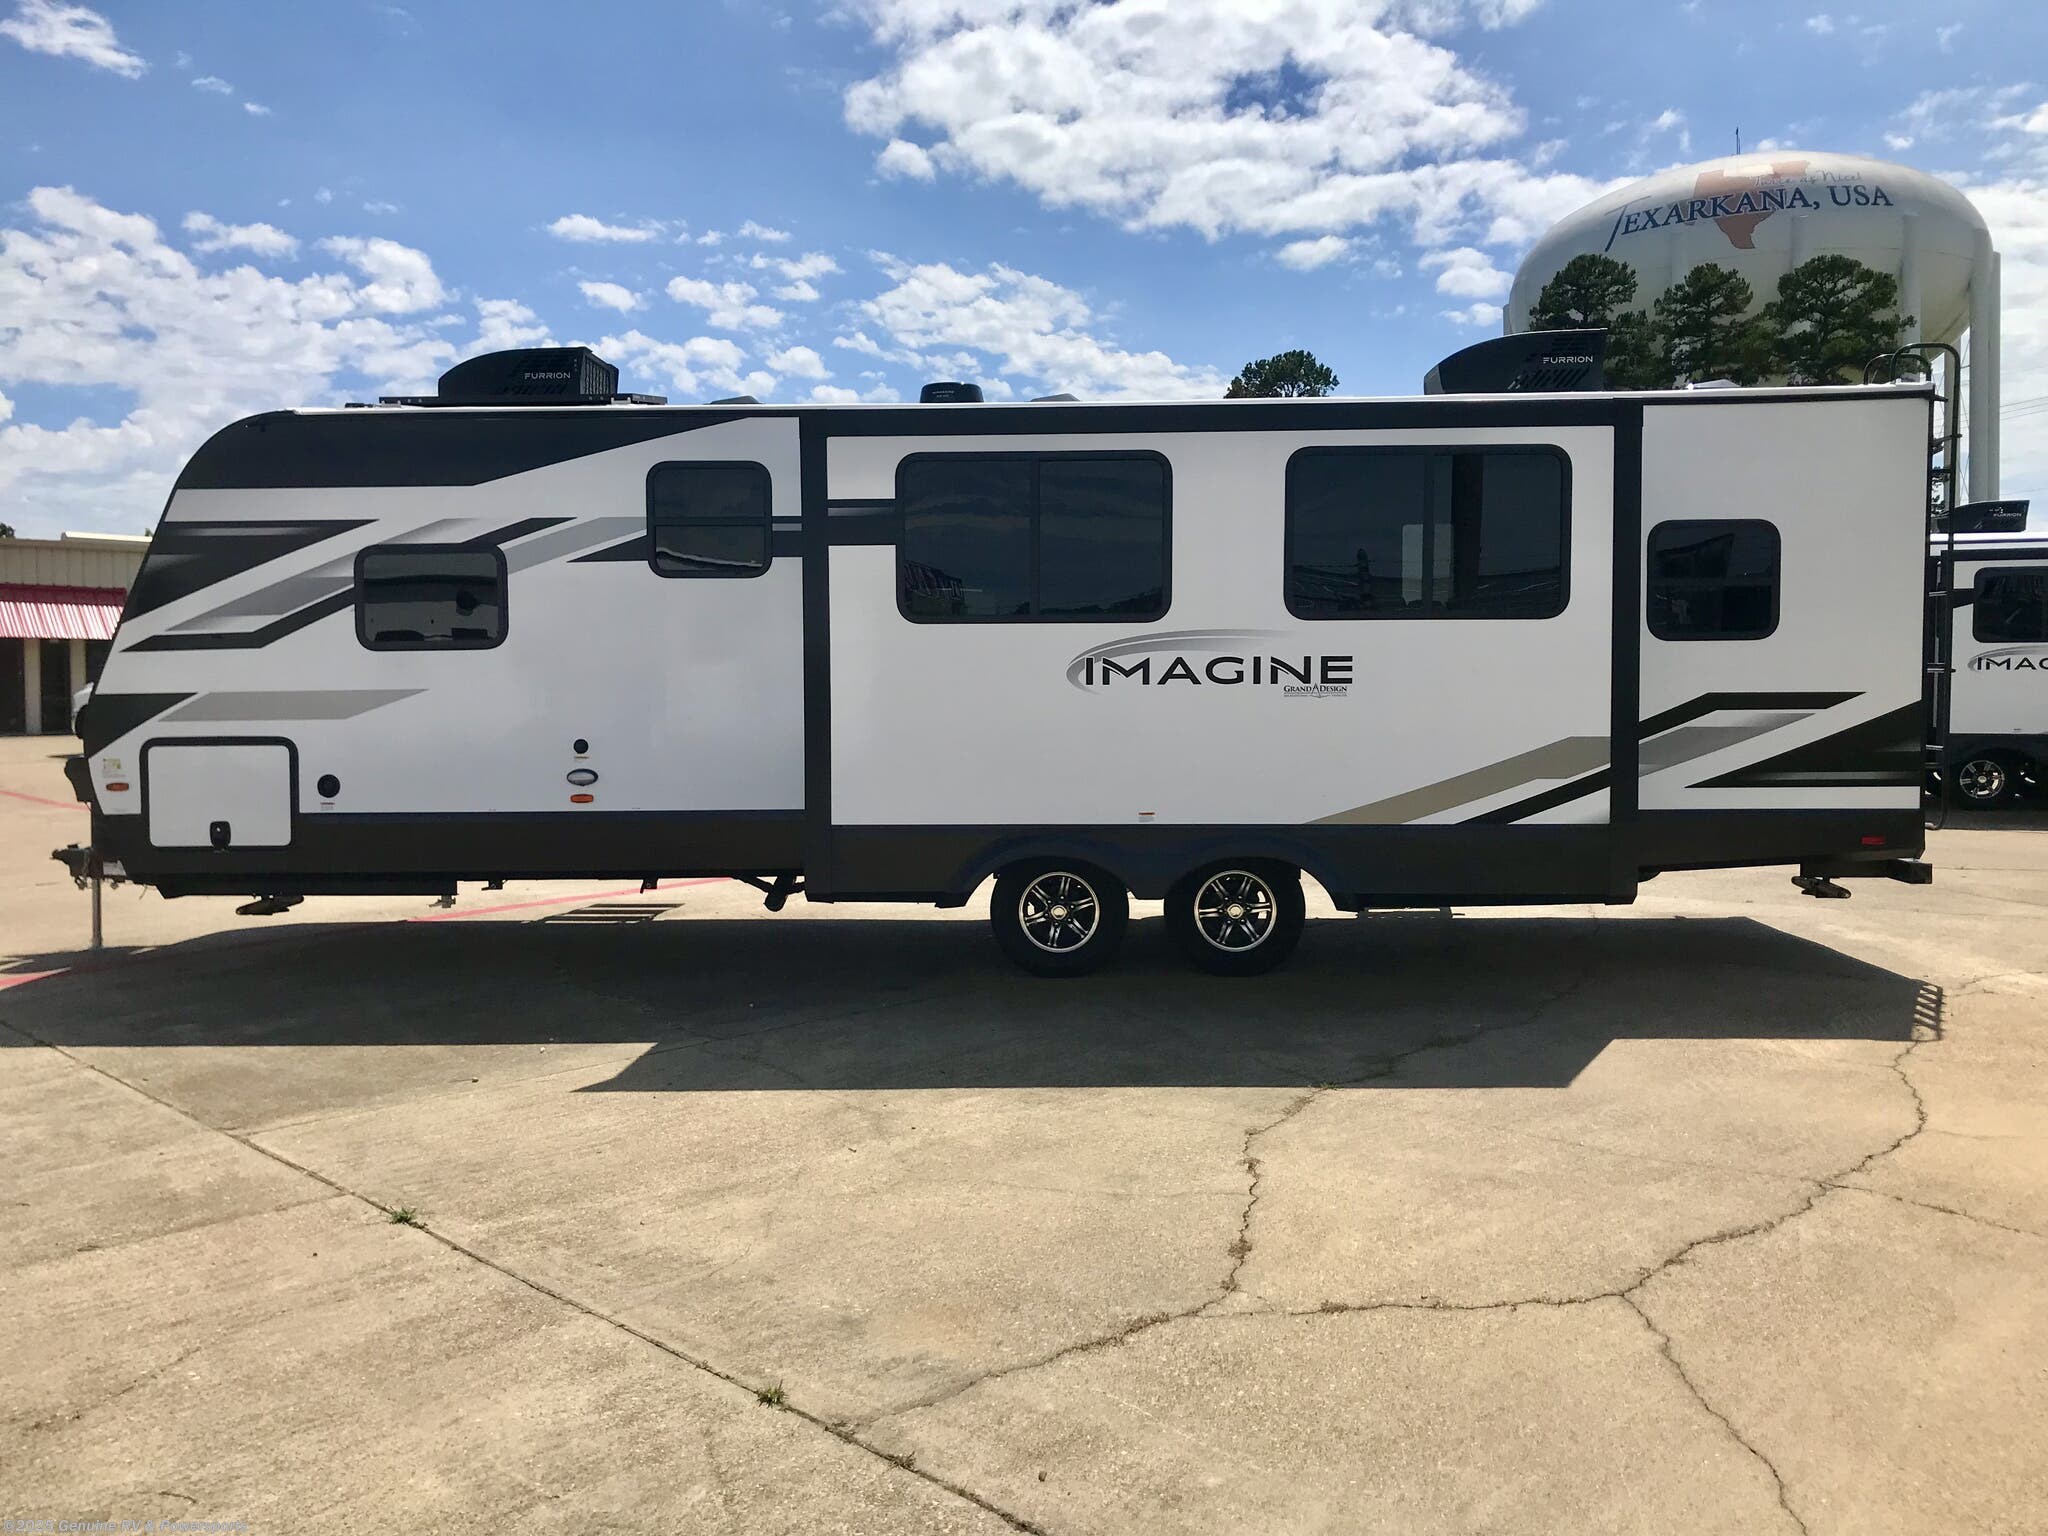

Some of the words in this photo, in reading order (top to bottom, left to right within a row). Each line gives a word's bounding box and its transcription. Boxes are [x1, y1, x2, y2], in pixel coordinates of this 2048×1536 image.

[1604, 187, 1820, 252] TEXARKANA,
[1827, 185, 1894, 207] USA
[1543, 356, 1593, 364] FURRION
[524, 372, 571, 380] FURRION
[1085, 656, 1353, 686] IMAGINE
